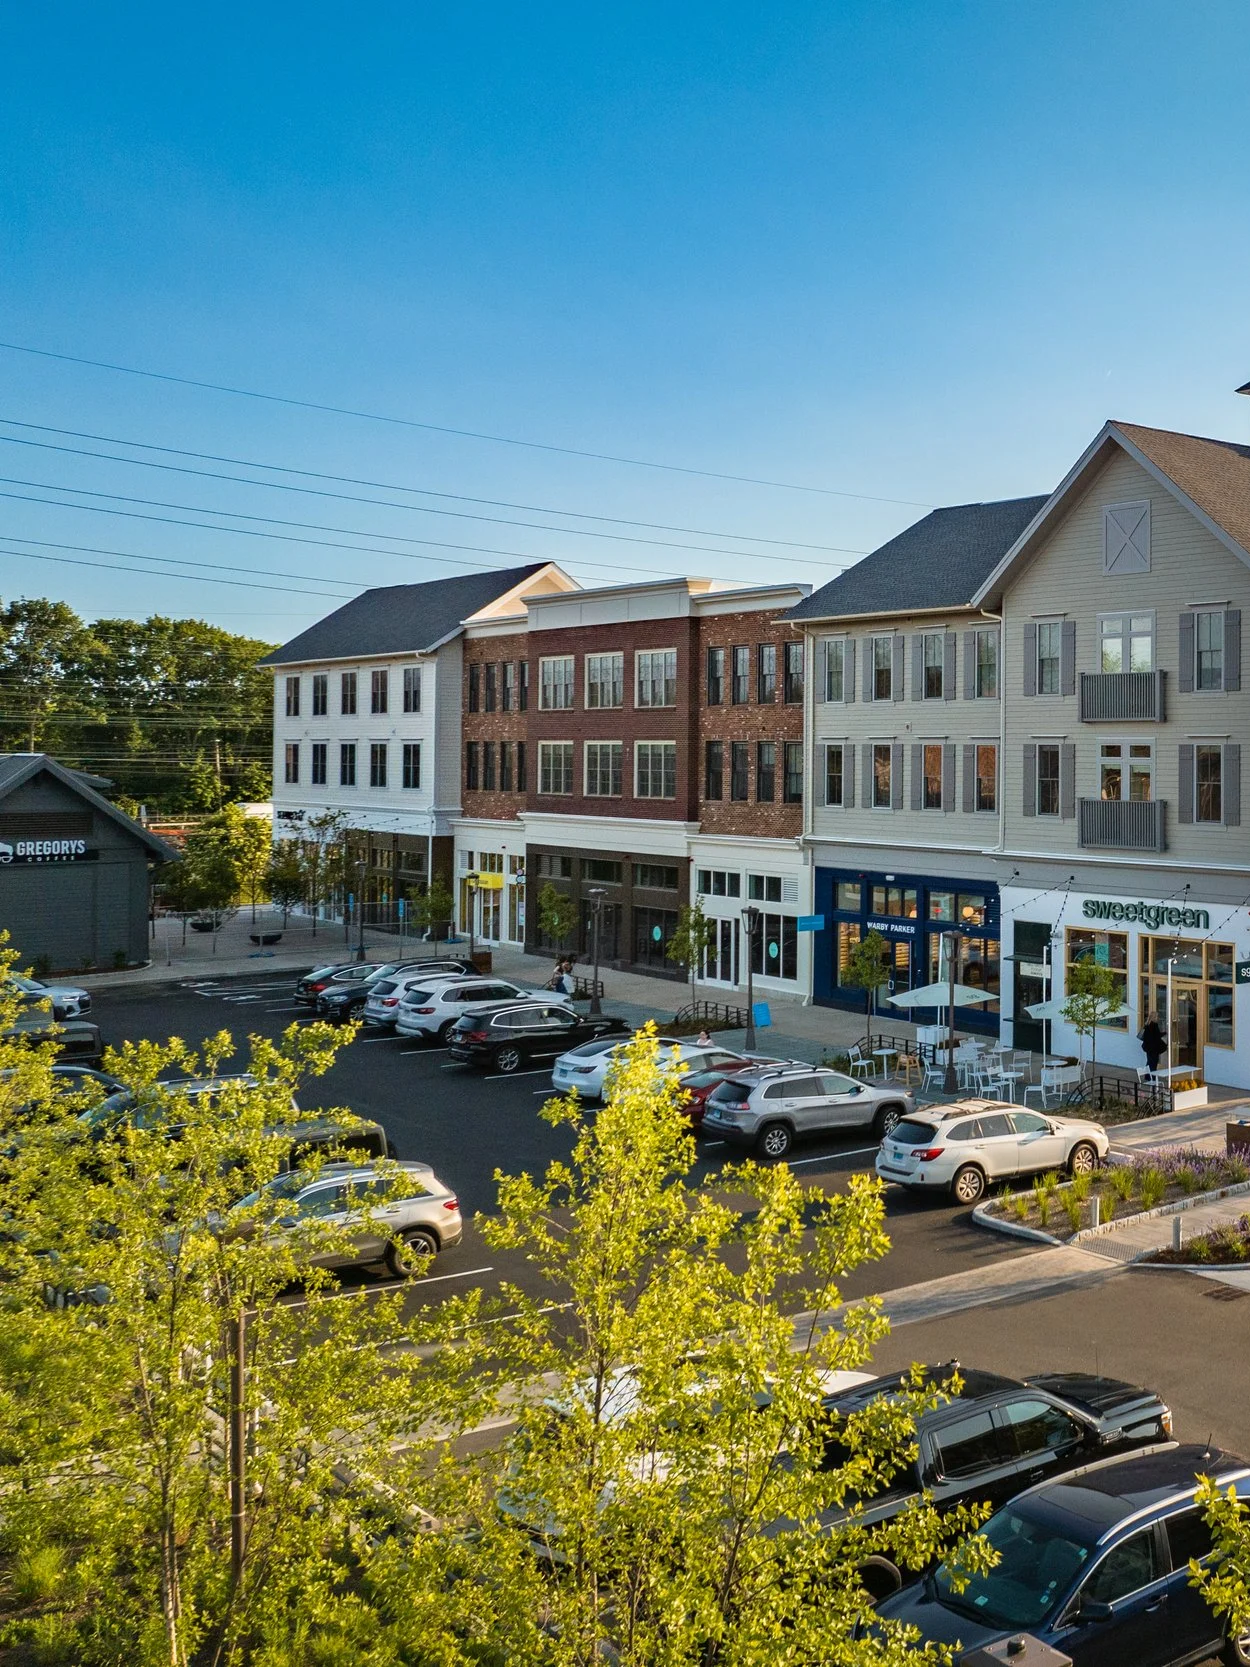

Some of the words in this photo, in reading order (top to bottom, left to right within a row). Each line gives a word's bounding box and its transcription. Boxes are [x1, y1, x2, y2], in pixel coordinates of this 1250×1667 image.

[16, 840, 86, 856] GREGORYS
[1082, 899, 1210, 930] sweetgreen
[866, 921, 889, 931] WARBY
[890, 924, 916, 934] PARKER
